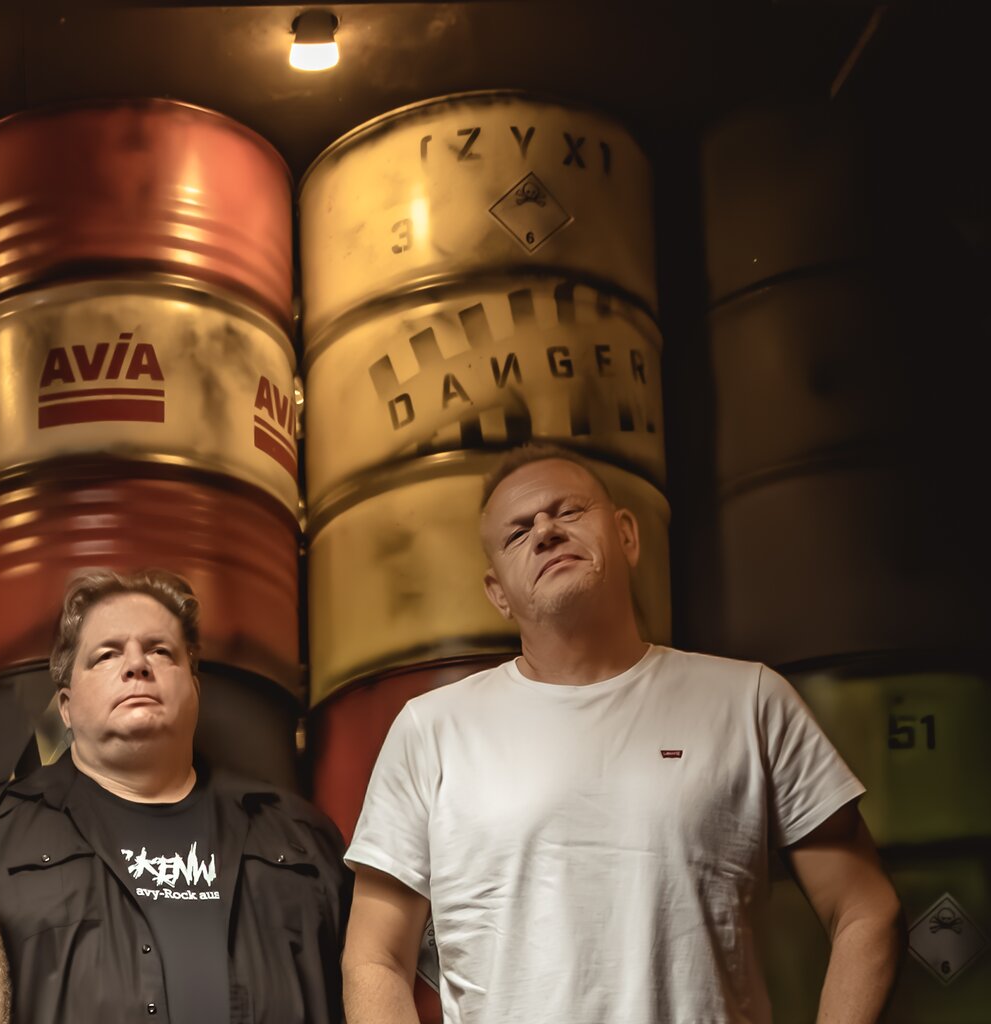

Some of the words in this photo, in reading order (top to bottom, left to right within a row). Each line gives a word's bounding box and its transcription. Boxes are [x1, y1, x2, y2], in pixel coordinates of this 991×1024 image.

[525, 231, 535, 245] 6
[39, 332, 165, 388] AVIA
[941, 960, 950, 974] 6
